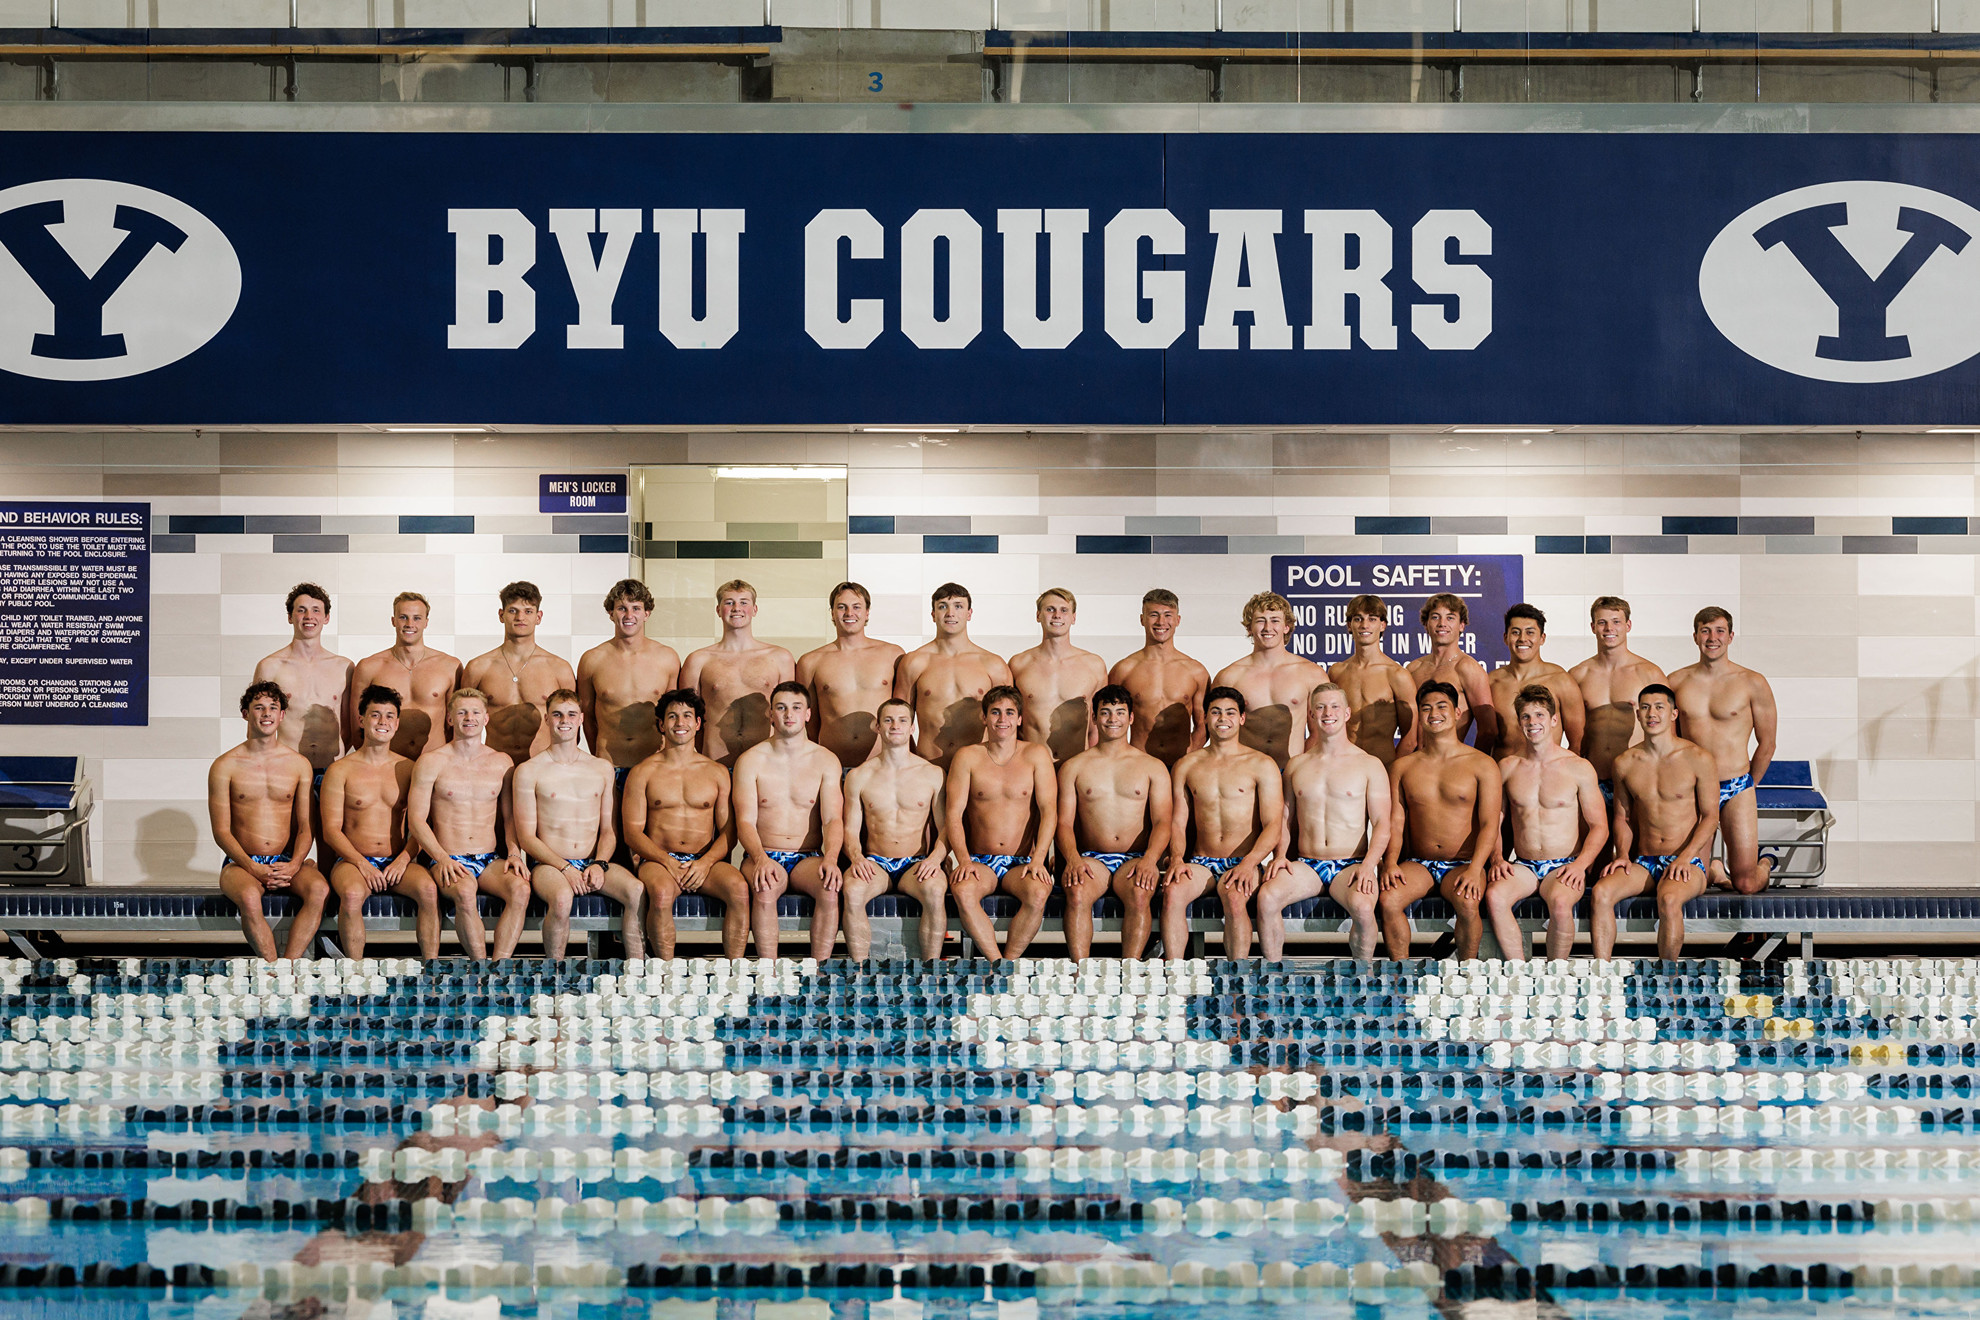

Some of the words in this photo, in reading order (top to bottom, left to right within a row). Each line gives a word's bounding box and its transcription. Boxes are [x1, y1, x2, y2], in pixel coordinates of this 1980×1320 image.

[868, 72, 884, 92] 3
[447, 208, 746, 349] BYU
[804, 208, 1493, 350] COUGARS
[1752, 201, 1973, 362] Y
[549, 481, 579, 493] MEN'S
[581, 481, 617, 493] LOCKER
[569, 495, 596, 507] ROOM
[24, 512, 89, 523] BEHAVIOR
[96, 513, 142, 524] RULES:
[1288, 565, 1360, 587] POOL
[1372, 565, 1481, 587] SAFETY:
[1294, 605, 1316, 626] NO
[1294, 633, 1316, 654] NO
[1392, 633, 1410, 654] IN
[1418, 632, 1476, 654] WER
[13, 844, 38, 871] 3
